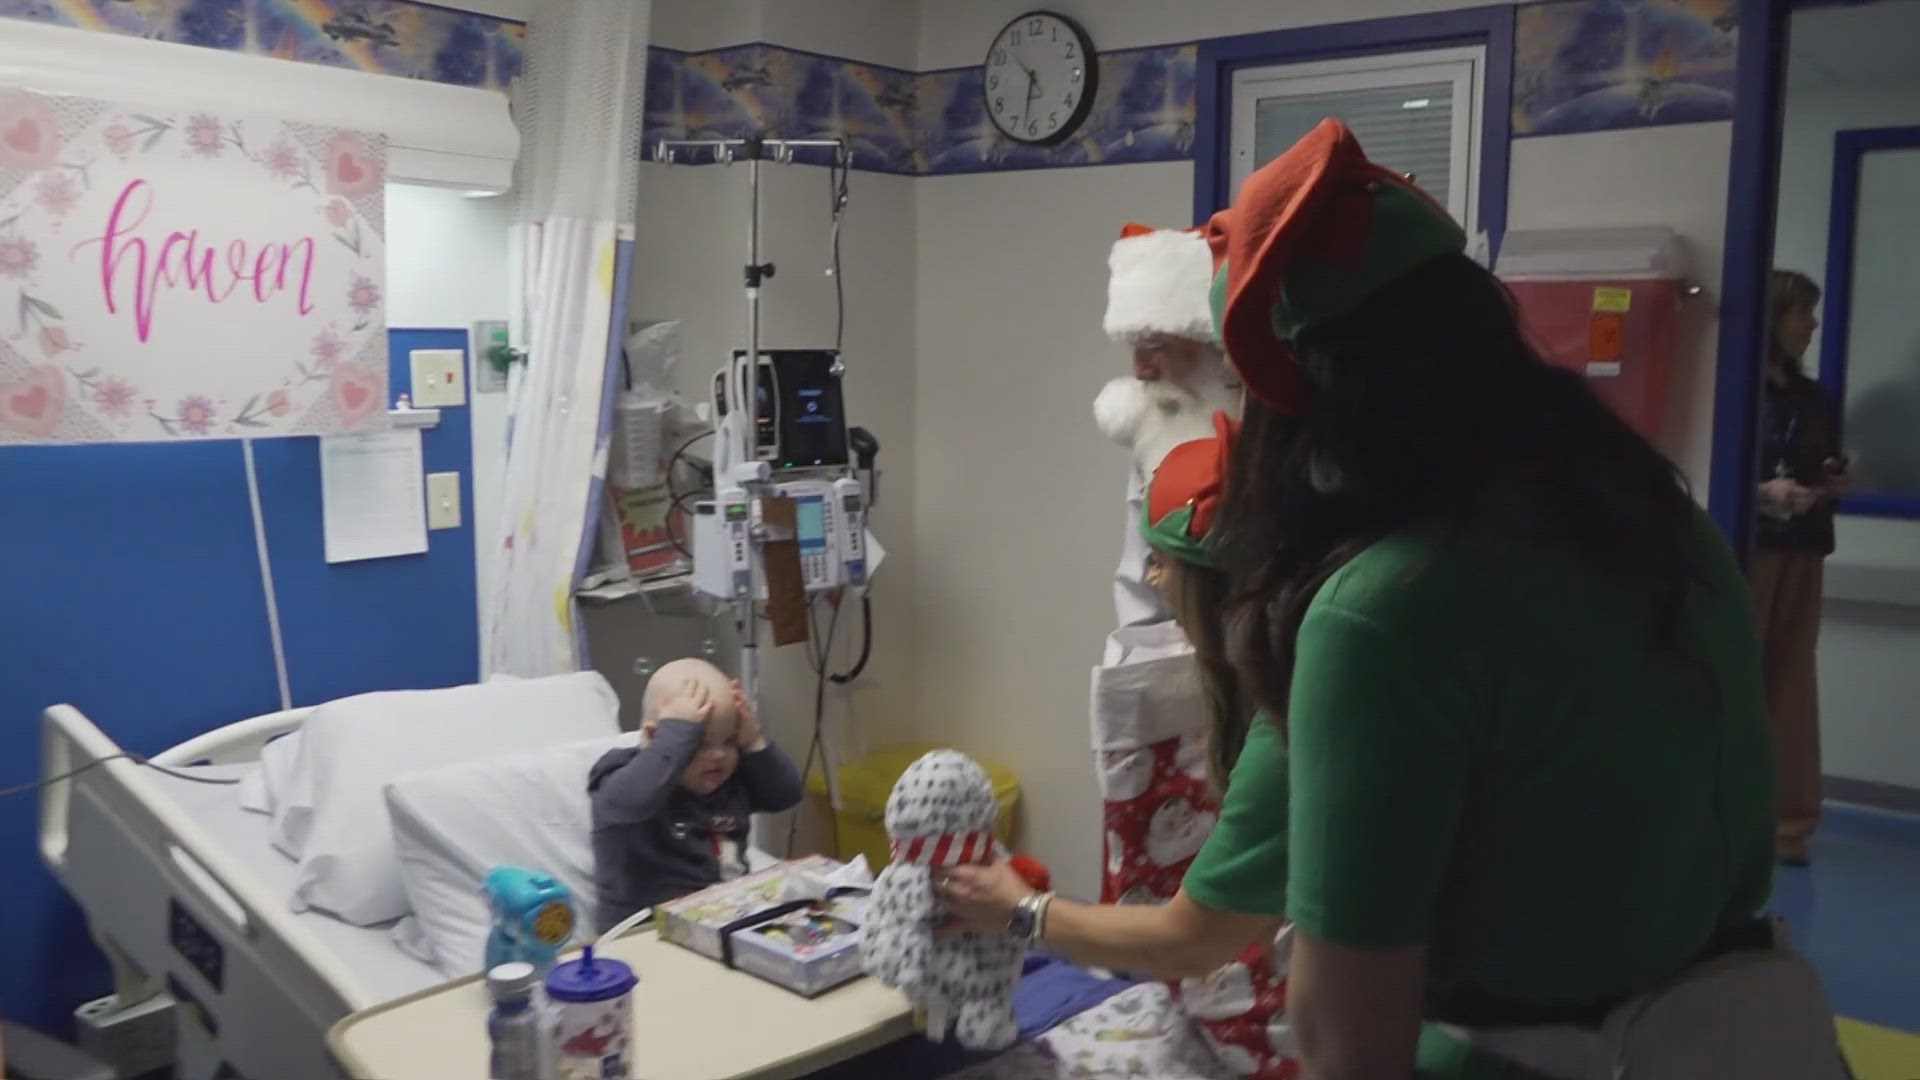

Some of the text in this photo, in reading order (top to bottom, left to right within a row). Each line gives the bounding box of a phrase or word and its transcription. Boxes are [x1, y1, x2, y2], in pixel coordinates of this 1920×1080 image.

[1028, 19, 1043, 36] 12
[1051, 27, 1057, 42] 1
[1010, 30, 1021, 46] 11
[992, 48, 1007, 66] 10
[1064, 42, 1074, 59] 2
[990, 75, 999, 90] 9
[1071, 66, 1081, 83] 3
[994, 97, 1004, 114] 8
[1064, 92, 1073, 109] 4
[1010, 116, 1019, 130] 7
[1028, 119, 1038, 136] 6
[1048, 112, 1057, 130] 5
[69, 178, 315, 343] haven
